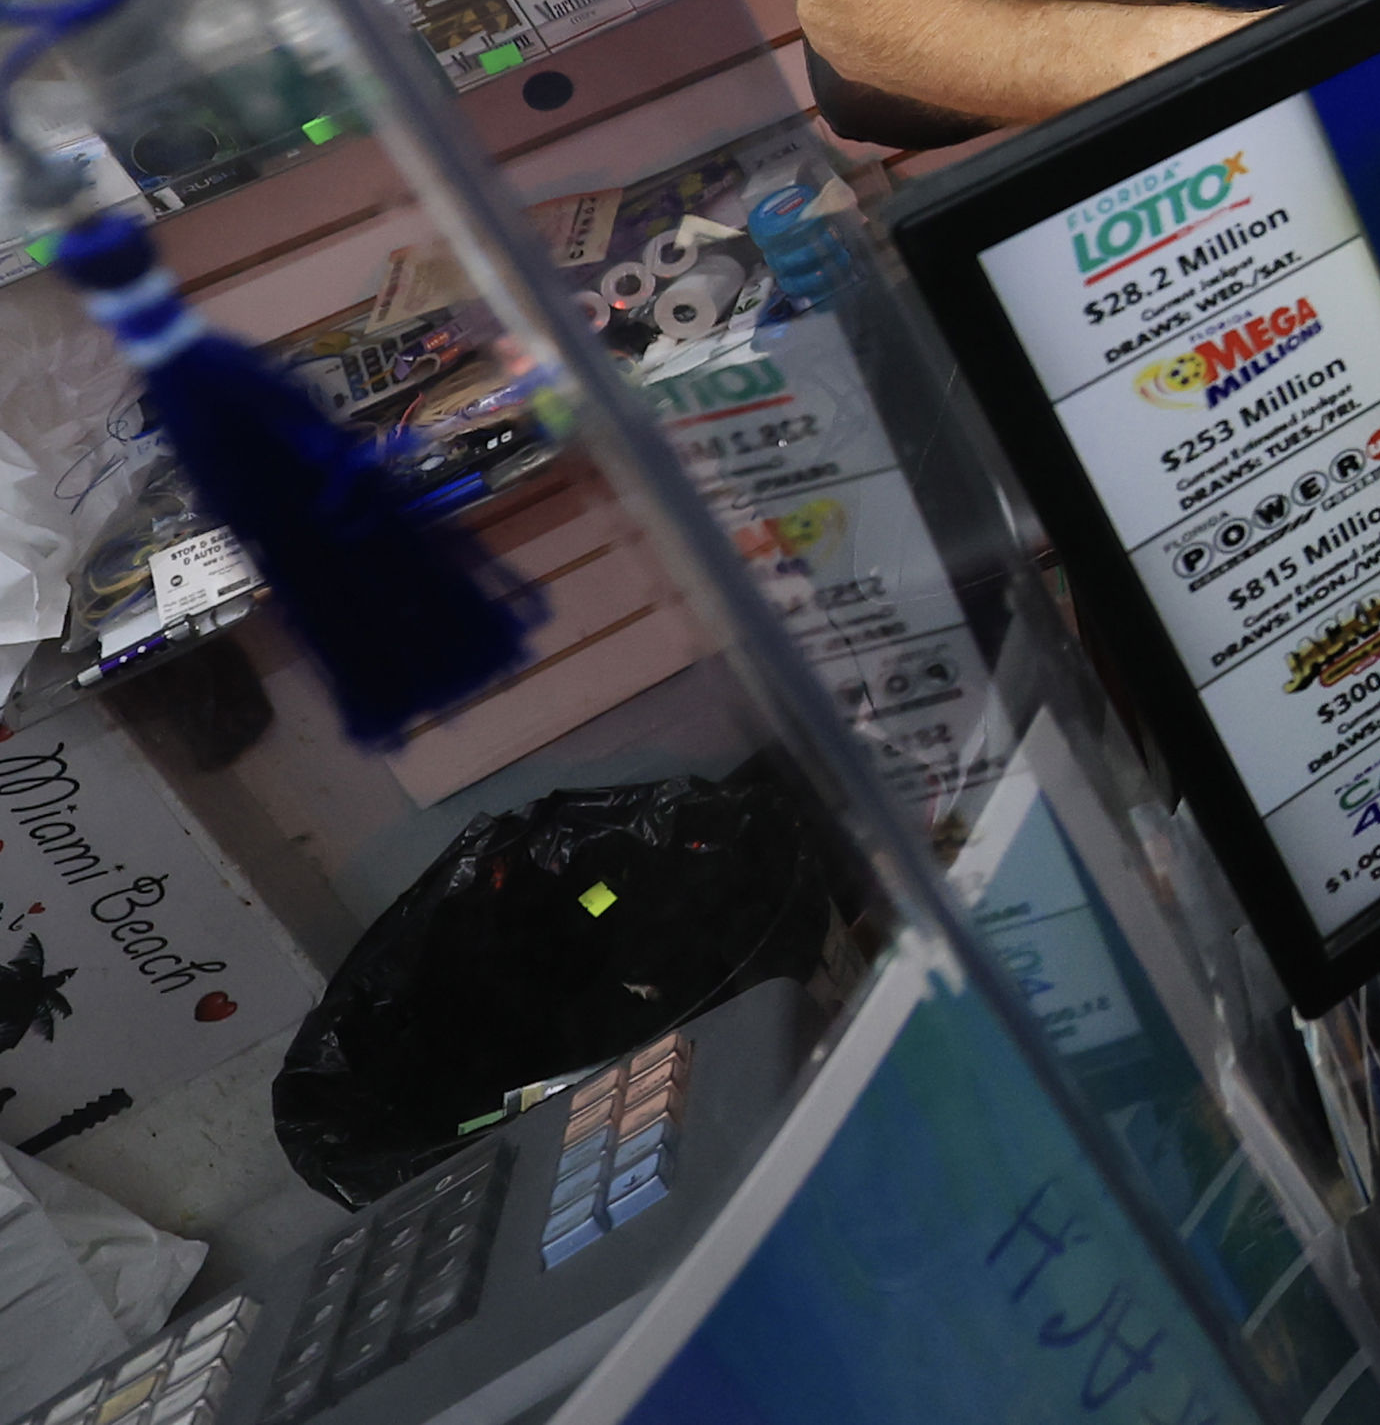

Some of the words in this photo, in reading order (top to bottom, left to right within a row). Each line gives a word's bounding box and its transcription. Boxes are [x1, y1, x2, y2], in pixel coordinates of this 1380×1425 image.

[1083, 267, 1174, 326] $28.2
[1179, 206, 1291, 276] Million
[1104, 311, 1193, 365] DRAWS:
[1141, 286, 1197, 323] Current
[1193, 296, 1318, 385] MEGA
[1205, 320, 1323, 410] MILLIONS
[1160, 418, 1235, 472] $253
[1239, 357, 1346, 428] Million
[1179, 456, 1262, 512] DRAWS:
[1228, 556, 1299, 611] $815
[1212, 612, 1292, 667] DRAWS:
[91, 874, 227, 994] Beach
